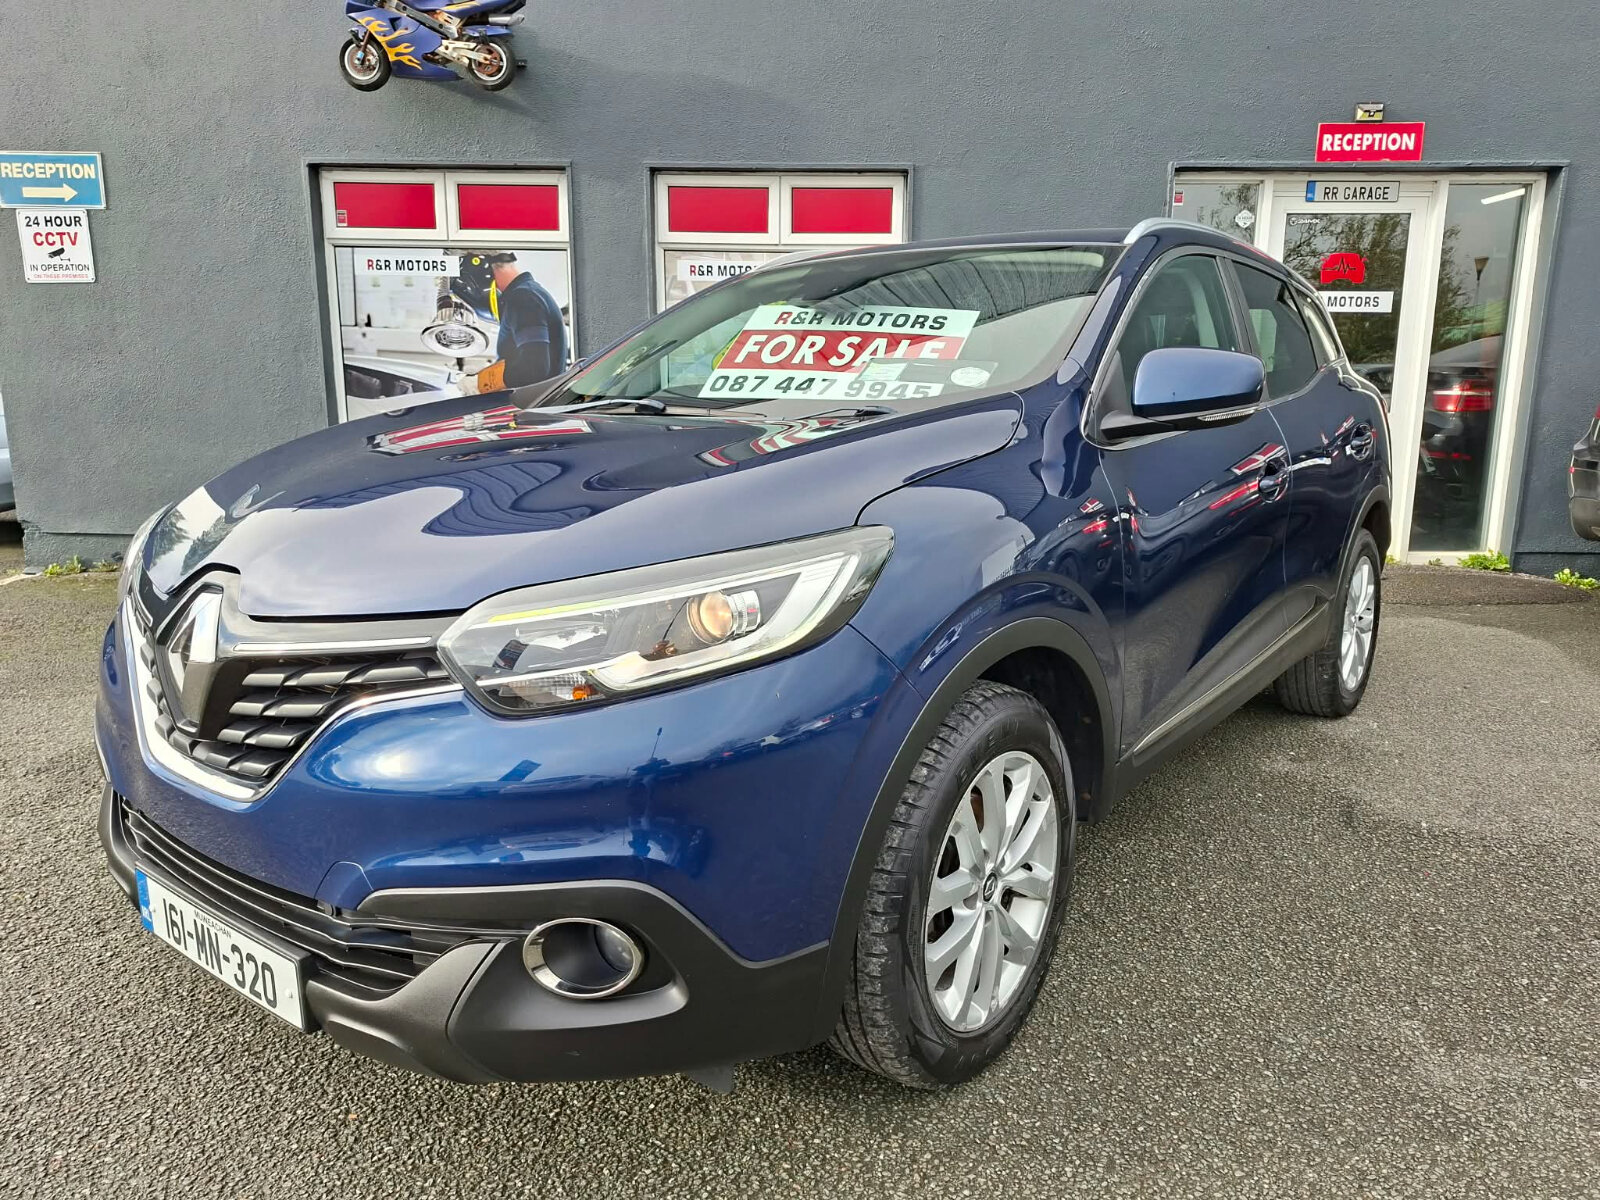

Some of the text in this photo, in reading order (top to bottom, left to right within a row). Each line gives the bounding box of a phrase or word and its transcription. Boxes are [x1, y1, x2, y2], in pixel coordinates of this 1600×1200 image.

[1322, 132, 1416, 152] RECEPTION
[0, 162, 96, 179] RECEPTION
[1323, 186, 1390, 200] RR GARAGE
[25, 216, 82, 227] 24 HOUR
[33, 232, 78, 246] CCTV
[367, 259, 447, 271] R&R MOTORS
[689, 264, 713, 276] R&R
[1327, 296, 1380, 307] MOTORS
[774, 311, 948, 331] R&R MOTORS
[734, 334, 947, 367] FOR SALE
[709, 375, 932, 399] 087 447 9945
[162, 898, 278, 1009] 161-MN-320
